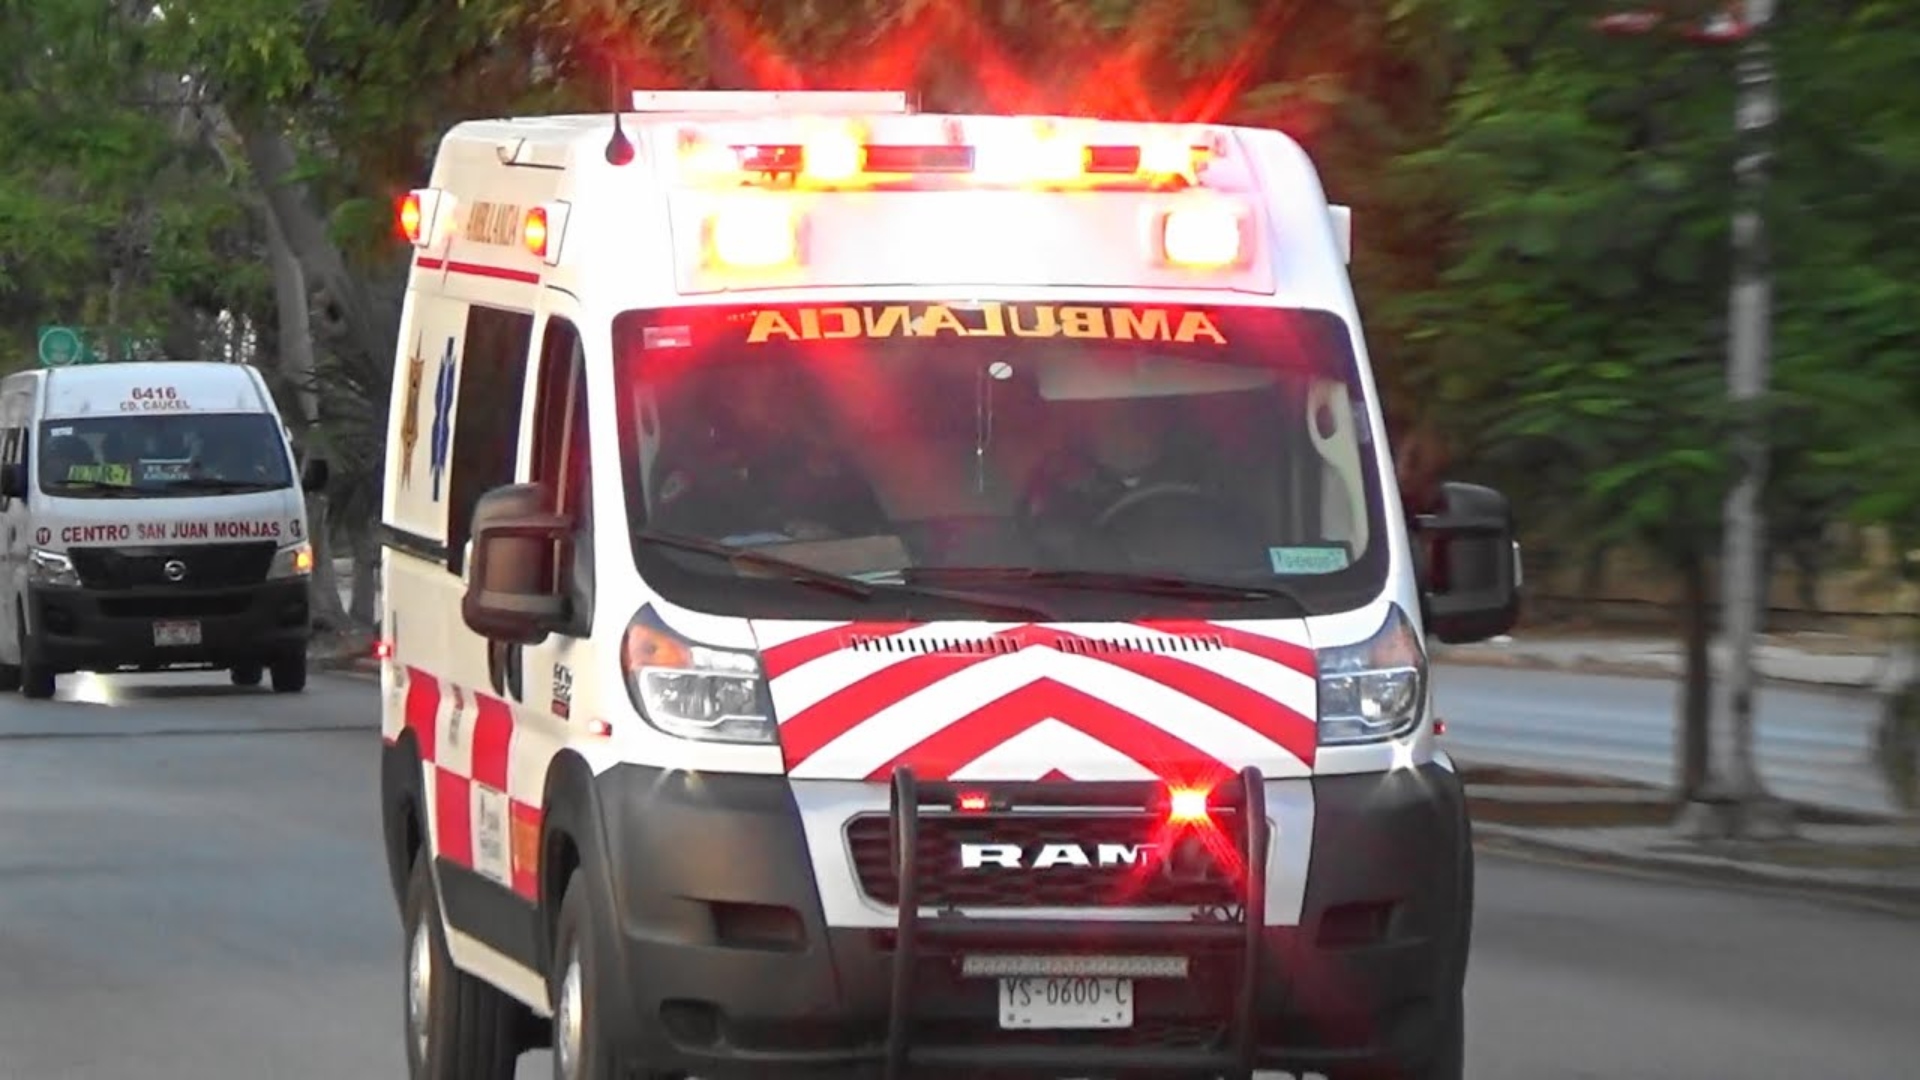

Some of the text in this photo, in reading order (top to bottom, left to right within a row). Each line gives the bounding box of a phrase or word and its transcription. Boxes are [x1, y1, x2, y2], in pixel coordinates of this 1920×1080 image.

[132, 387, 177, 400] 6416
[143, 400, 190, 410] CAUCEL
[61, 525, 130, 543] CENTRO
[137, 524, 166, 539] SAN
[171, 523, 208, 539] JUAN
[214, 521, 281, 537] MONJAS
[961, 843, 1159, 868] RAM
[1006, 977, 1127, 1007] YS-0600-C
